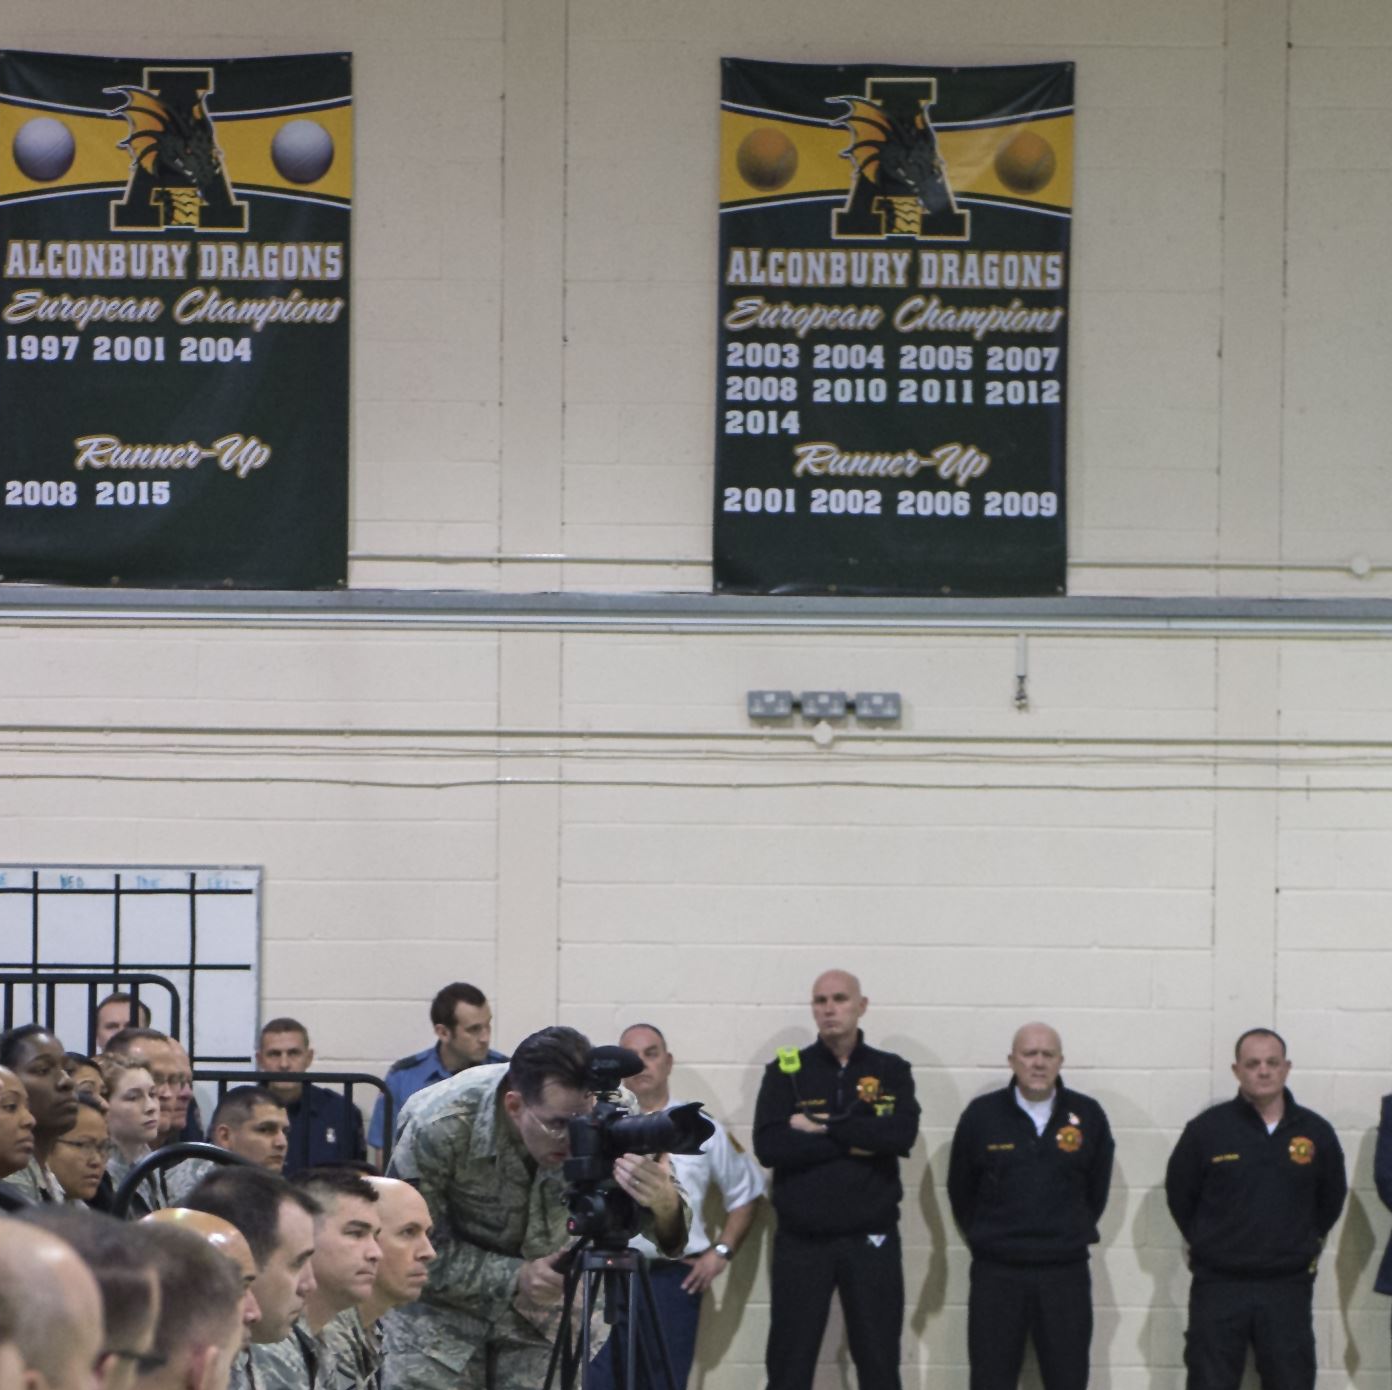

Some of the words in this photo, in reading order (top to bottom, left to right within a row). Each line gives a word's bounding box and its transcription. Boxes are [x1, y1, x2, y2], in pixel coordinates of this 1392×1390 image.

[3, 240, 191, 279] ALCONBURY
[197, 241, 343, 280] DRAGONS
[726, 248, 911, 288] ALCONBURY
[918, 250, 1064, 289] DRAGONS
[2, 289, 164, 330] European
[173, 287, 344, 332] Champions
[724, 296, 885, 339] European
[894, 295, 1064, 341] Champions
[6, 335, 79, 361] 1997
[93, 336, 165, 361] 2001
[180, 336, 251, 362] 2004
[726, 342, 799, 368] 2003
[813, 344, 884, 370] 2004
[899, 345, 972, 371] 2005
[986, 346, 1059, 372] 2007
[726, 375, 797, 401] 2008
[813, 378, 887, 403] 2010
[898, 379, 973, 404] 2011
[985, 380, 1060, 405] 2012
[725, 410, 800, 435] 2014
[74, 433, 271, 479] Runner-Up
[793, 442, 990, 487] Runner-Up
[5, 480, 77, 506] 2008
[95, 481, 170, 506] 2015
[723, 487, 796, 513] 2001
[810, 489, 882, 515] 2002
[897, 490, 971, 516] 2006
[984, 492, 1057, 517] 2009
